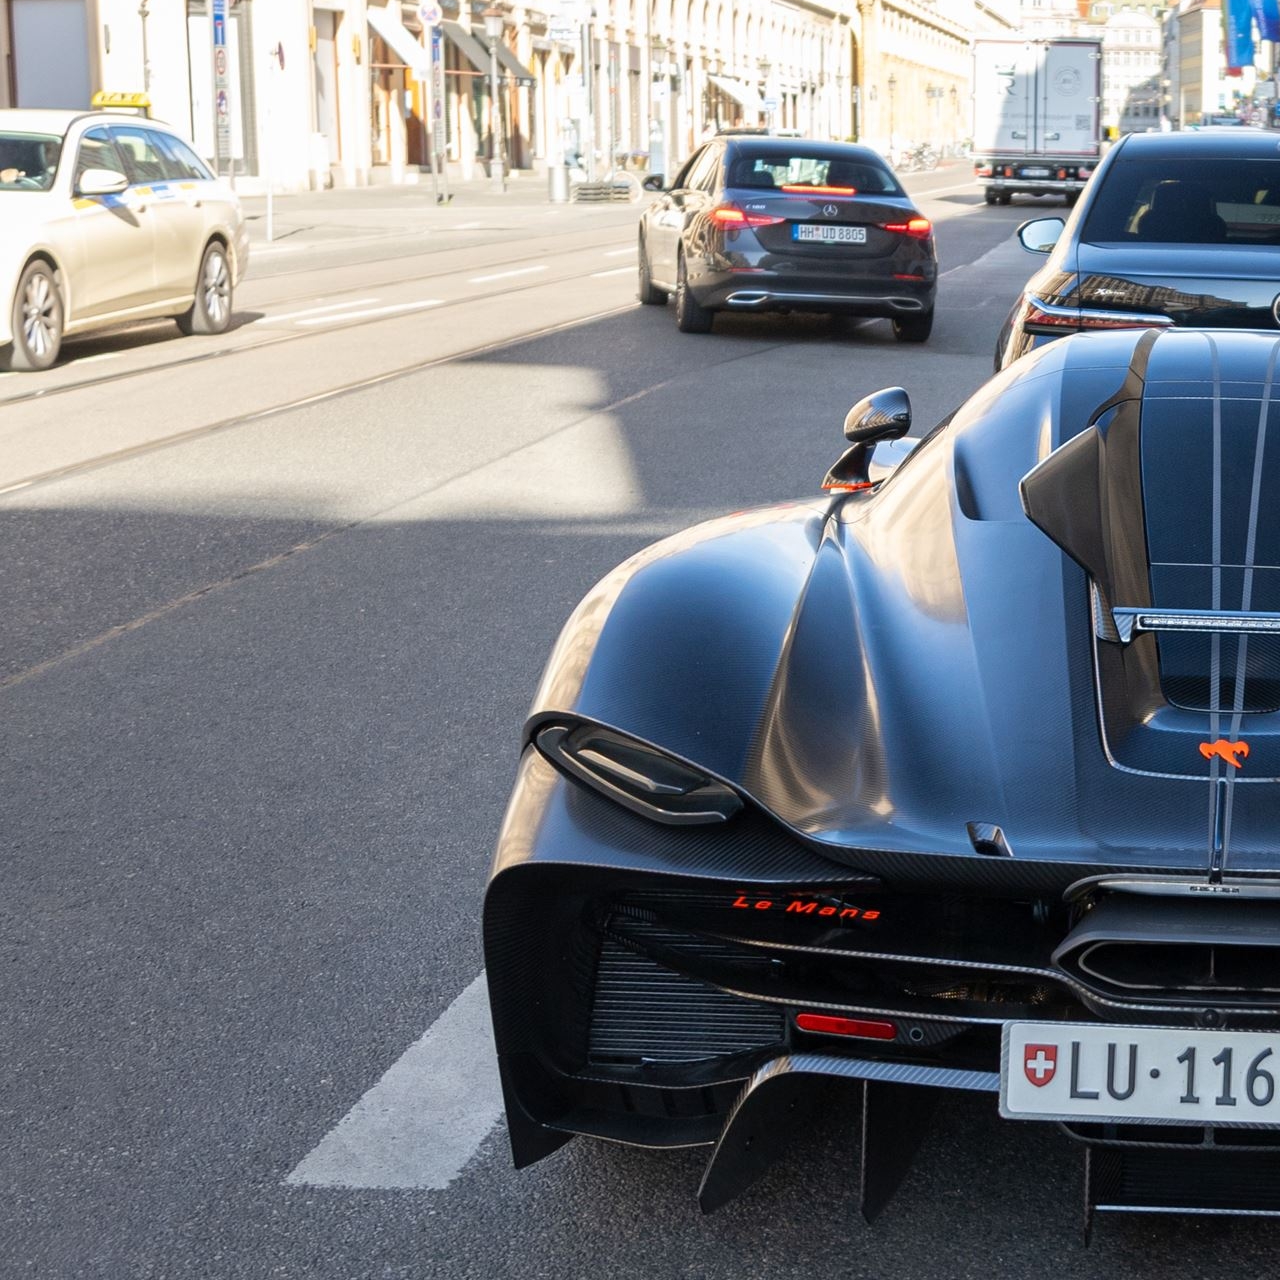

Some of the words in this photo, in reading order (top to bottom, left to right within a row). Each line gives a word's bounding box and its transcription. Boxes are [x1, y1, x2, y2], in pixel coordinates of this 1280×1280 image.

[800, 227, 814, 238] HH
[733, 896, 772, 909] Le
[786, 901, 880, 919] Mans
